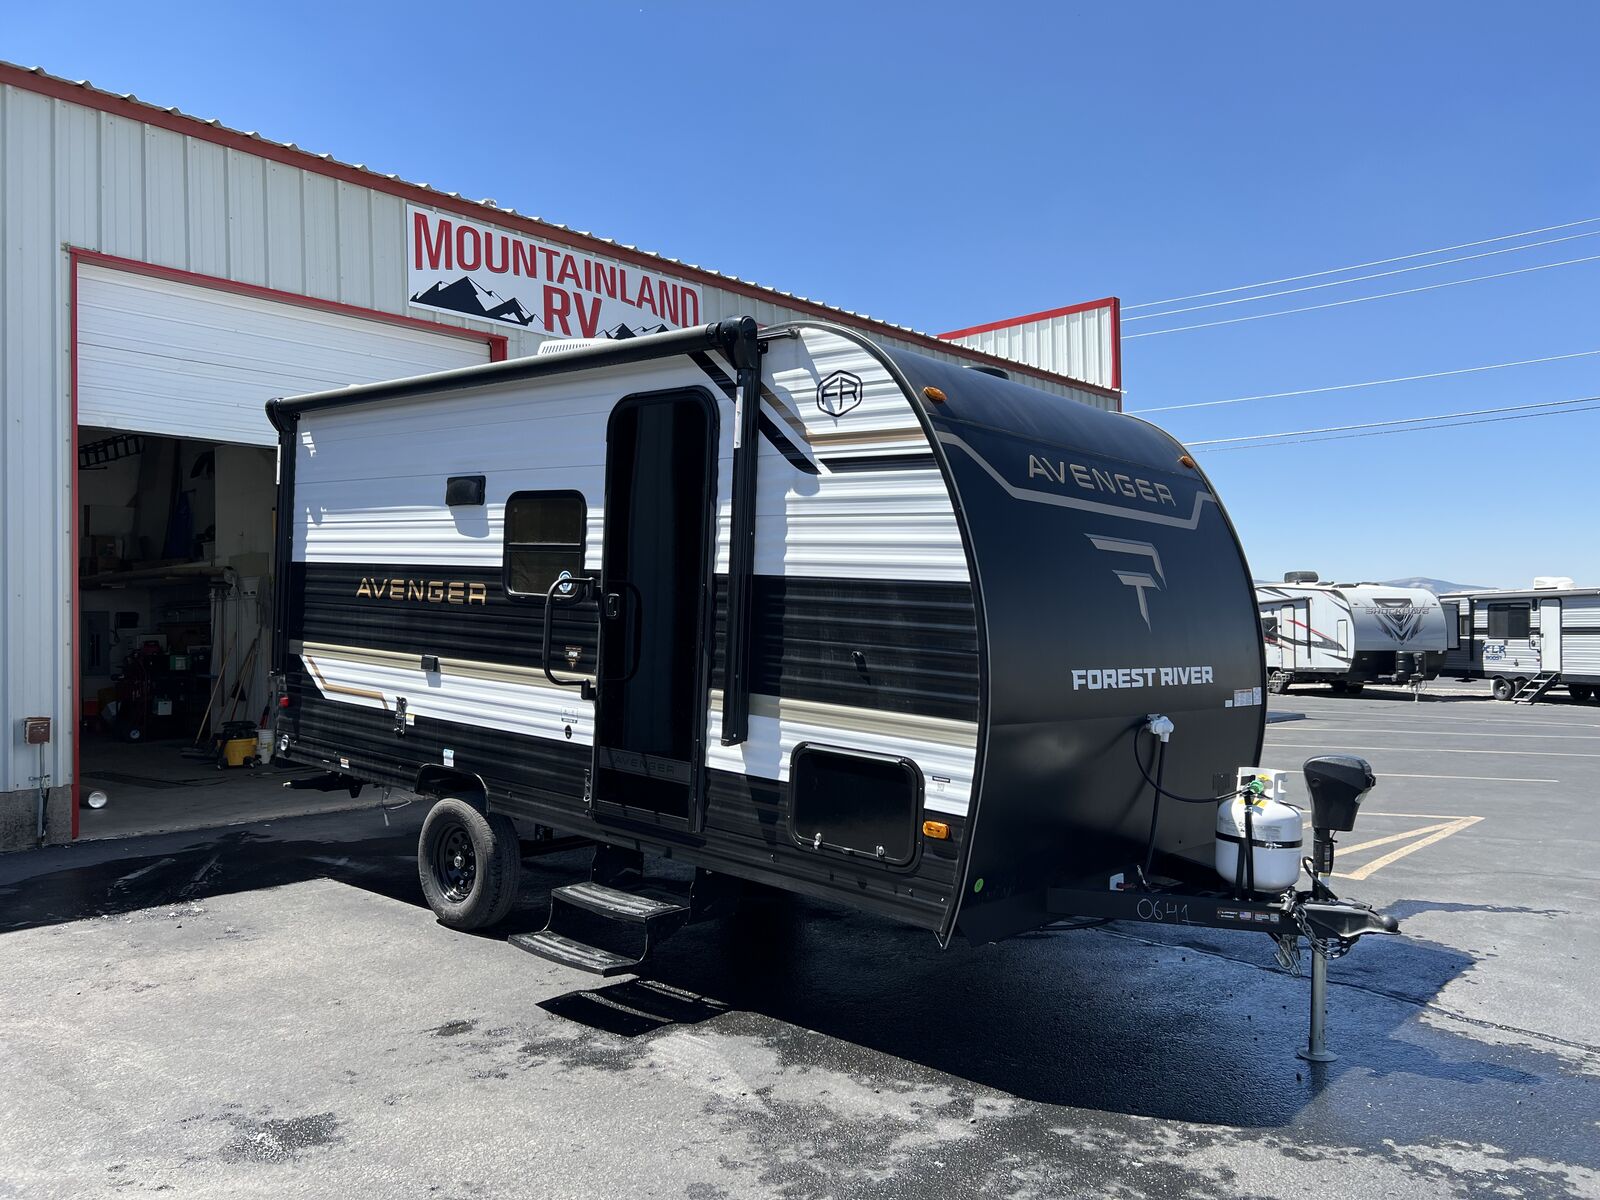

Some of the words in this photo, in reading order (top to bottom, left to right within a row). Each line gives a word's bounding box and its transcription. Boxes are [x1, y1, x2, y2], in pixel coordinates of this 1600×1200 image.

[414, 212, 699, 328] MOUNTAINLAND
[543, 284, 602, 338] RV
[1029, 454, 1176, 506] AVENGER
[356, 577, 487, 606] AVENGER
[1072, 668, 1156, 690] FOREST
[1160, 666, 1213, 686] RIVER
[1137, 899, 1206, 925] 0641
